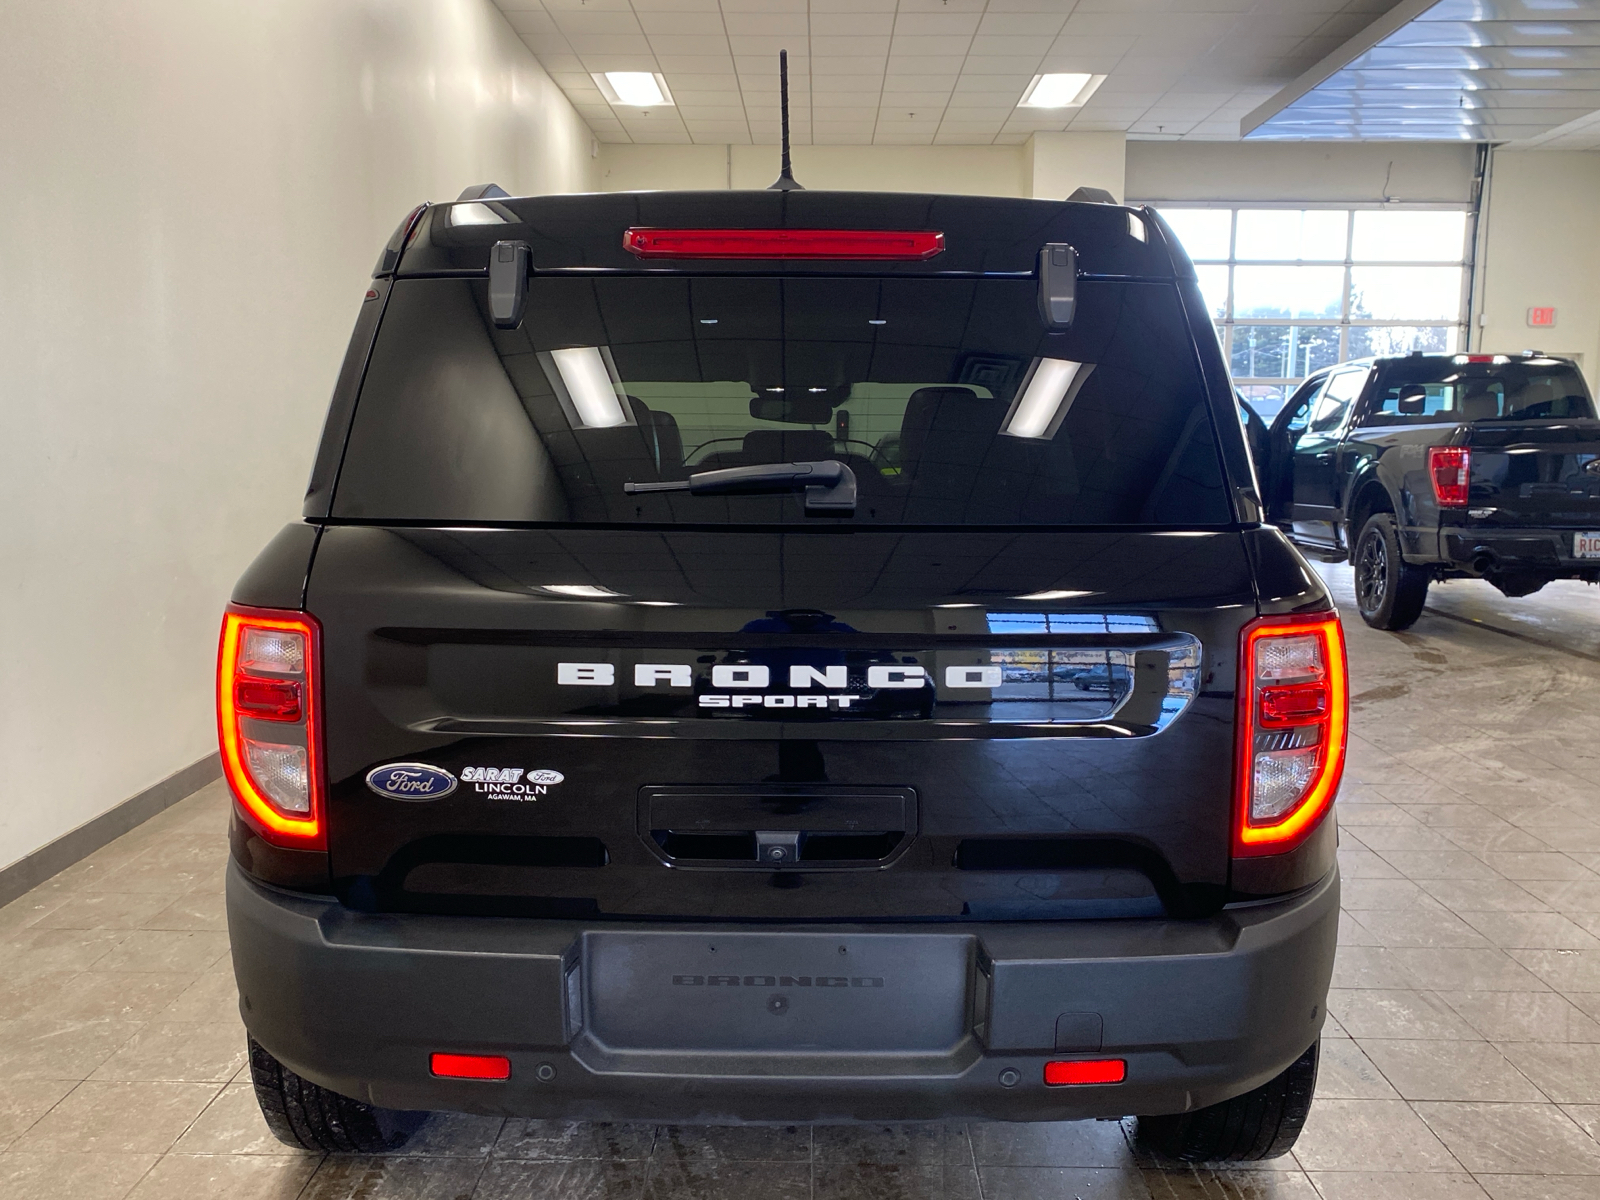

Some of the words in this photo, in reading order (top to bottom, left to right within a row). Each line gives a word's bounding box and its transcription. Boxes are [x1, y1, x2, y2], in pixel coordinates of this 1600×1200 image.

[1532, 306, 1555, 325] EXIT
[557, 662, 1003, 689] BRONCO
[698, 694, 861, 708] SPORT
[386, 770, 435, 793] Ford
[460, 766, 524, 783] SARAT
[532, 772, 558, 782] Ford
[475, 783, 548, 795] LINCOLN
[487, 793, 524, 802] AGAWAM,
[672, 975, 885, 988] BRONCO
